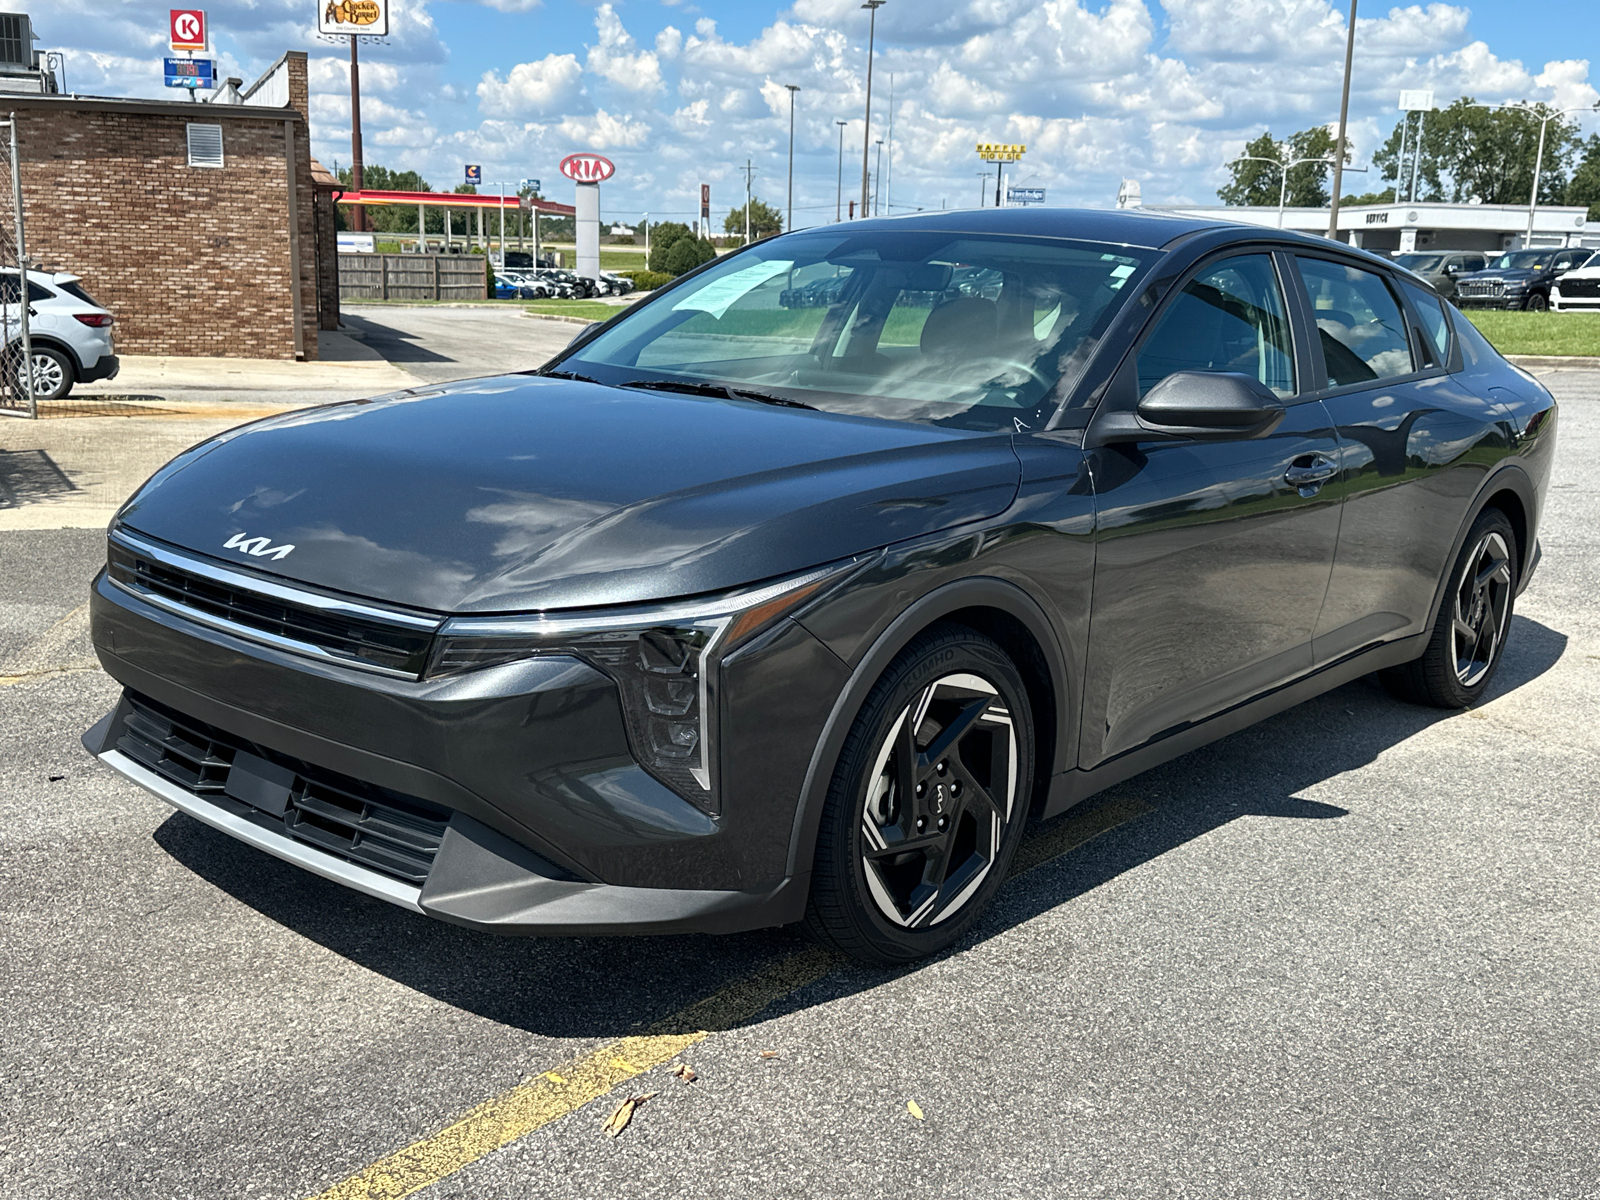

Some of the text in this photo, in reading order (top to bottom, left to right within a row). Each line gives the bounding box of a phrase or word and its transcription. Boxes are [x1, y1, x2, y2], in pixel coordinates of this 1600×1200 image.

[350, 10, 377, 24] Barrel
[181, 19, 198, 37] K
[976, 144, 1026, 153] WAFFLE
[569, 159, 605, 179] KIA
[902, 649, 955, 691] KUMHO
